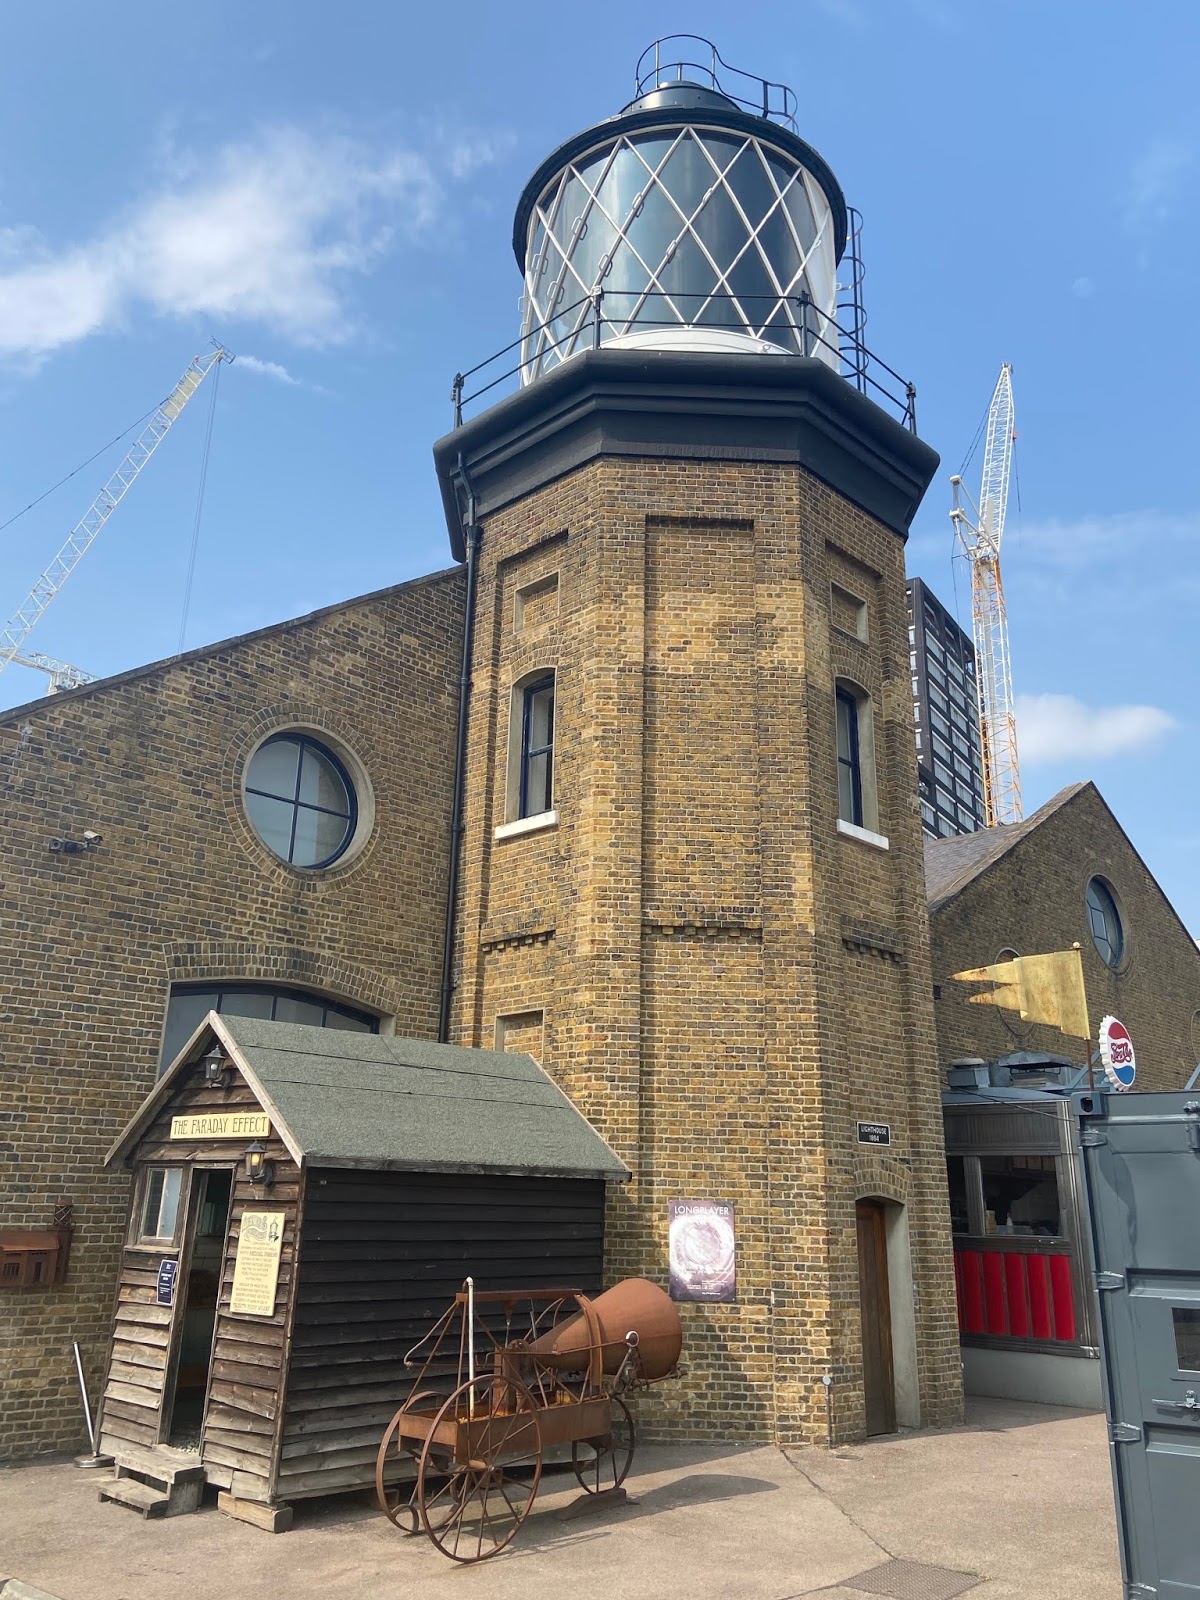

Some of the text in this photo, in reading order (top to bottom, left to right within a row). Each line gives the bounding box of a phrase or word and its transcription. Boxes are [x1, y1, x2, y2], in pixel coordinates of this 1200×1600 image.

[173, 1116, 268, 1135] THE FARADAY EFFECT
[860, 1125, 887, 1135] LIGHTHOUSE
[674, 1205, 729, 1216] LONGPLAYER
